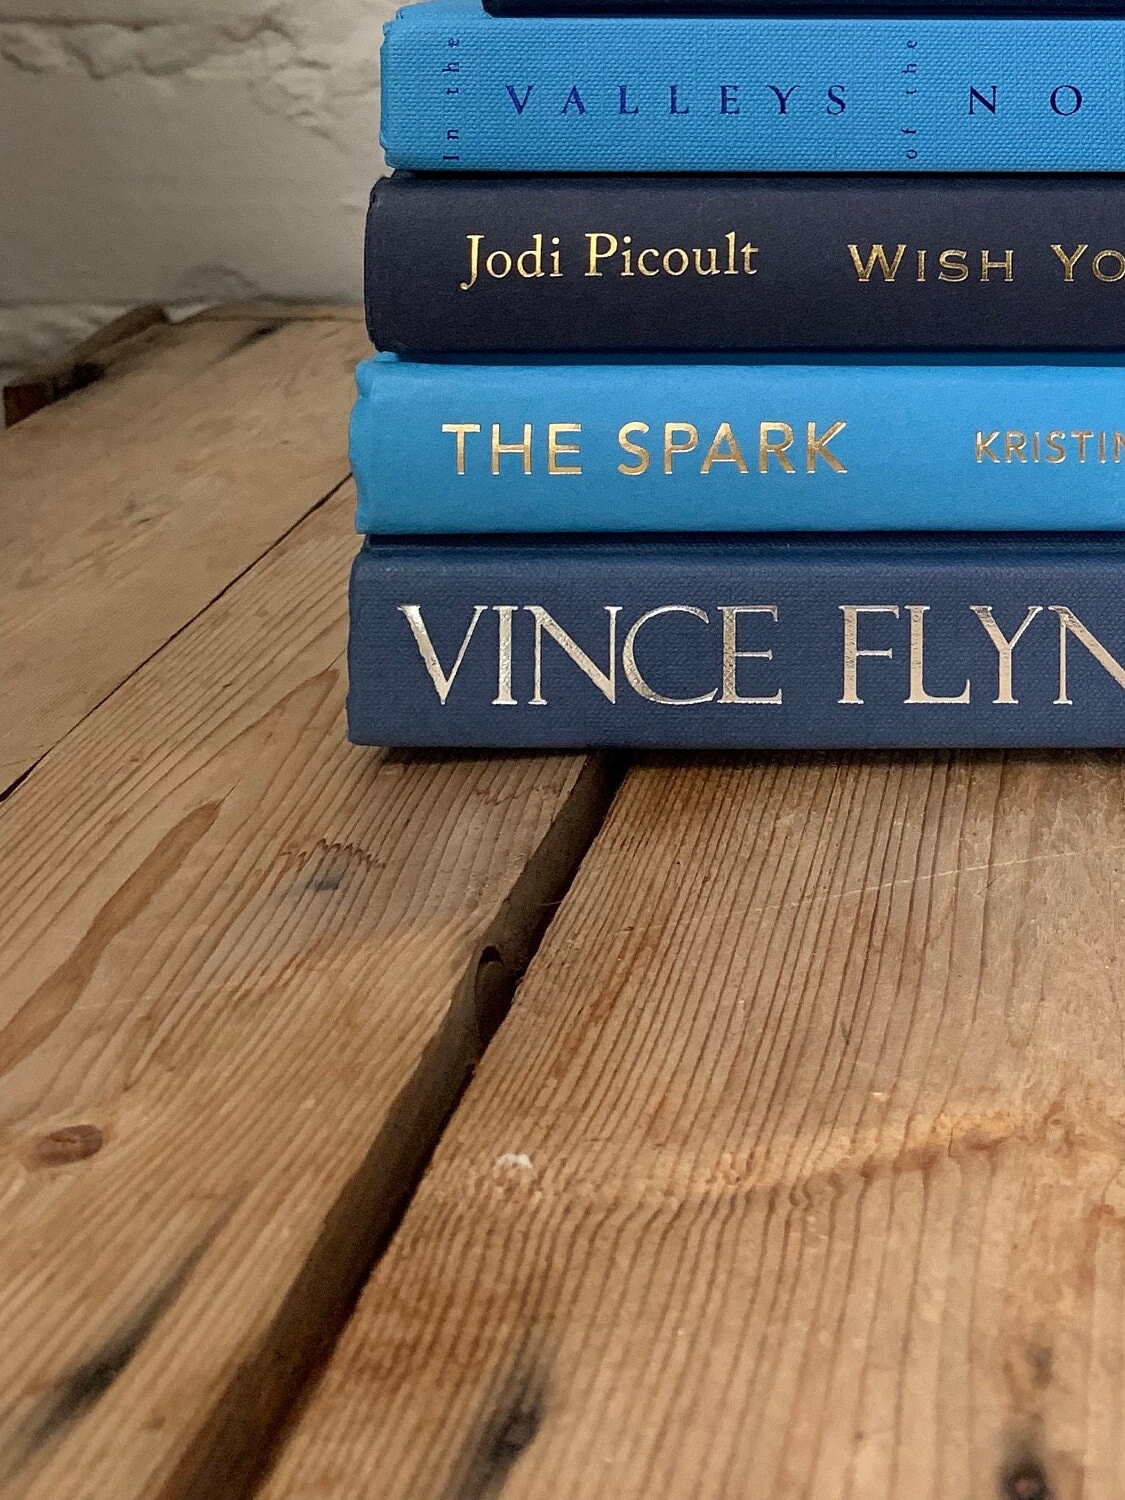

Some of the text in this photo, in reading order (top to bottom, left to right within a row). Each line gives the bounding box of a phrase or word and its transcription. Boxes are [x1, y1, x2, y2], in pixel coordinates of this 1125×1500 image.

[442, 37, 460, 161] In the
[506, 84, 847, 116] VALLEYS
[901, 39, 918, 160] of the
[460, 232, 760, 291] Jodi Picoult
[441, 421, 849, 476] THE SPARK
[397, 604, 784, 706] VINCE
